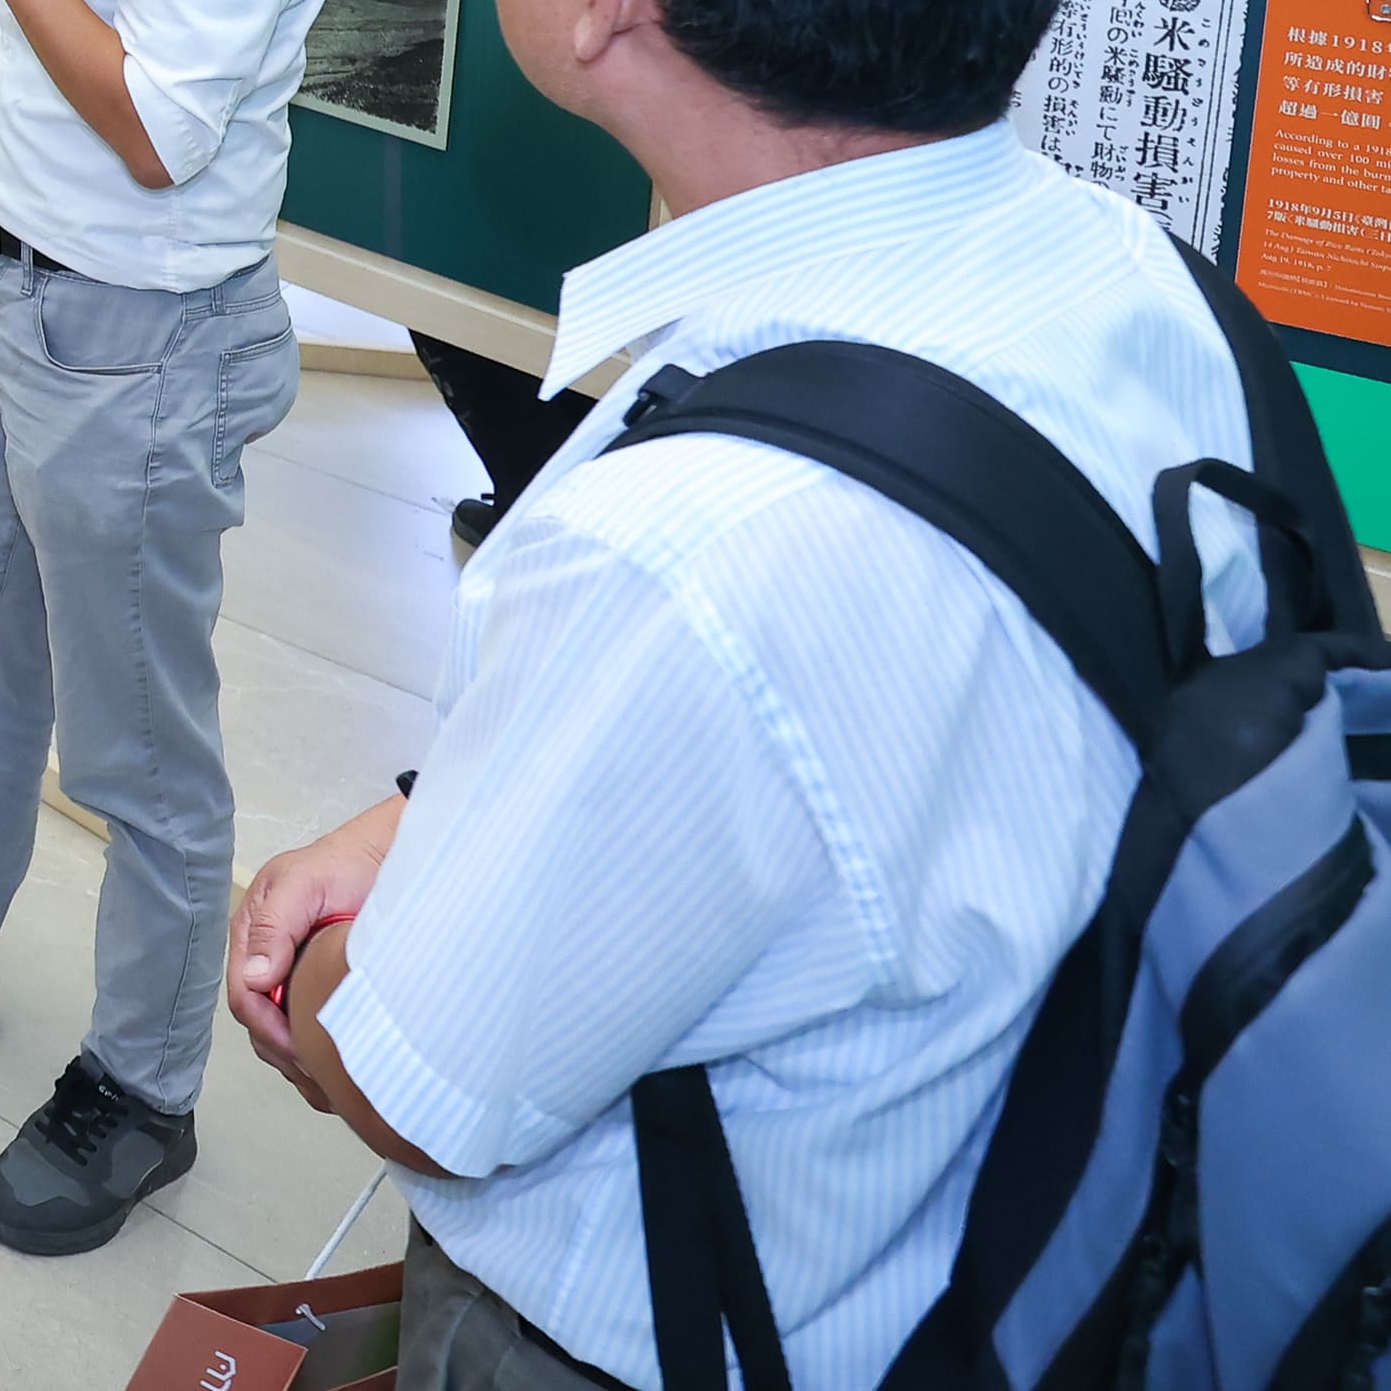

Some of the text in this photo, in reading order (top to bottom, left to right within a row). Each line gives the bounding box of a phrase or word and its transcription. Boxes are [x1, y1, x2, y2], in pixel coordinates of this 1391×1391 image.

[1284, 51, 1391, 80] 所造成的財
[1283, 75, 1384, 105] 等有形損害
[1275, 129, 1333, 148] According
[1337, 138, 1349, 149] to
[1353, 143, 1360, 151] a
[1272, 153, 1305, 166] losses
[1309, 159, 1336, 172] from
[1341, 163, 1360, 176] the
[1274, 142, 1312, 155] caused
[1317, 150, 1343, 161] over
[1350, 153, 1370, 165] 100
[1271, 166, 1320, 183] property
[1323, 173, 1344, 186] and
[1347, 176, 1378, 192] other
